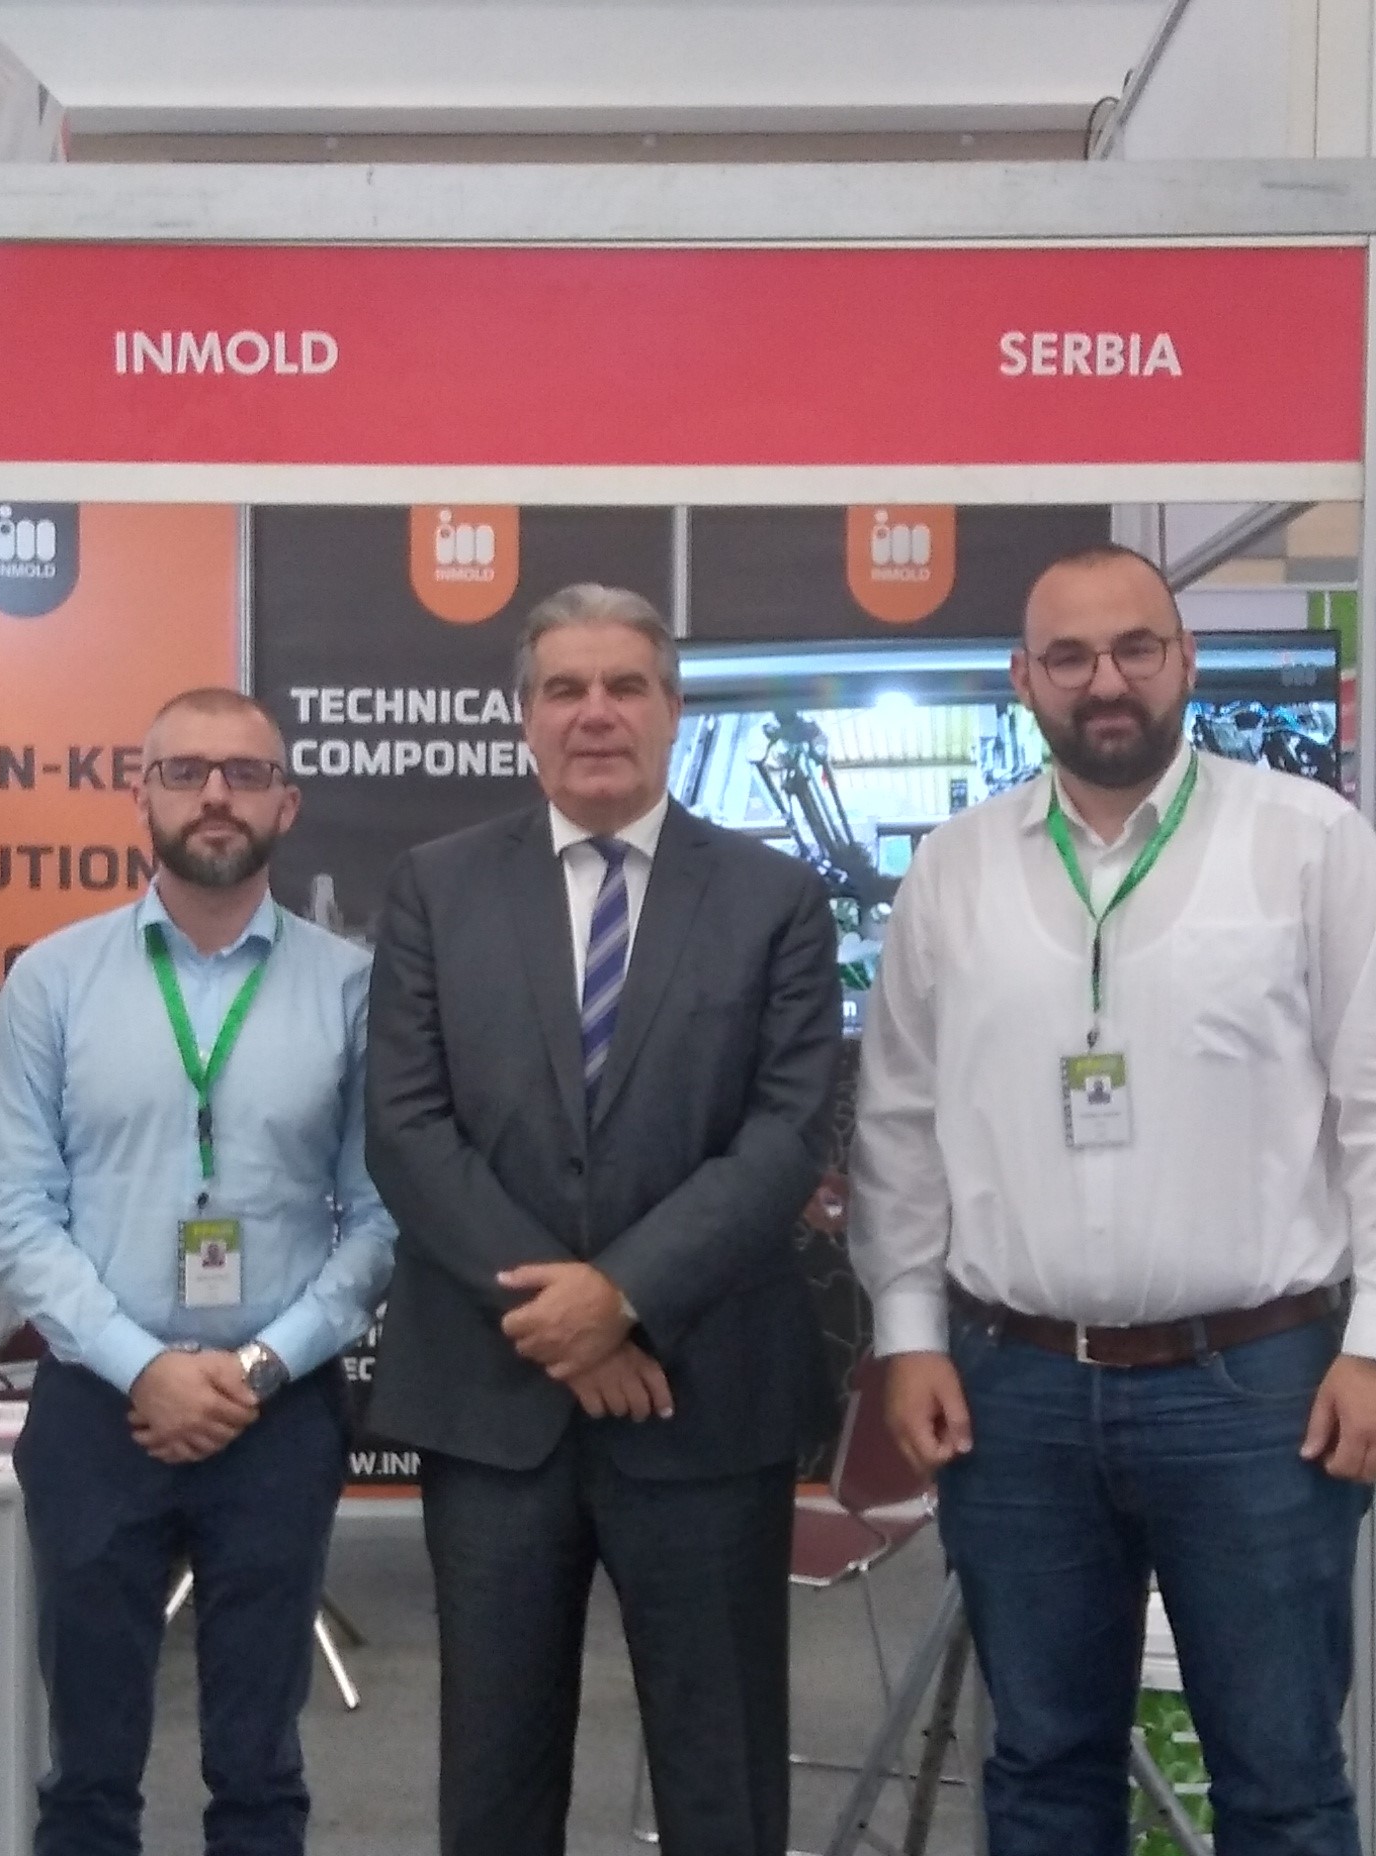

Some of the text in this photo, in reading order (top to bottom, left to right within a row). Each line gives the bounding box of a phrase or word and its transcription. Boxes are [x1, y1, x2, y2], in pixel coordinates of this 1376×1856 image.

[115, 329, 339, 375] INMOLD
[999, 330, 1183, 377] SERBIA
[435, 566, 495, 582] INMOLD
[291, 739, 540, 777] COMPONEN
